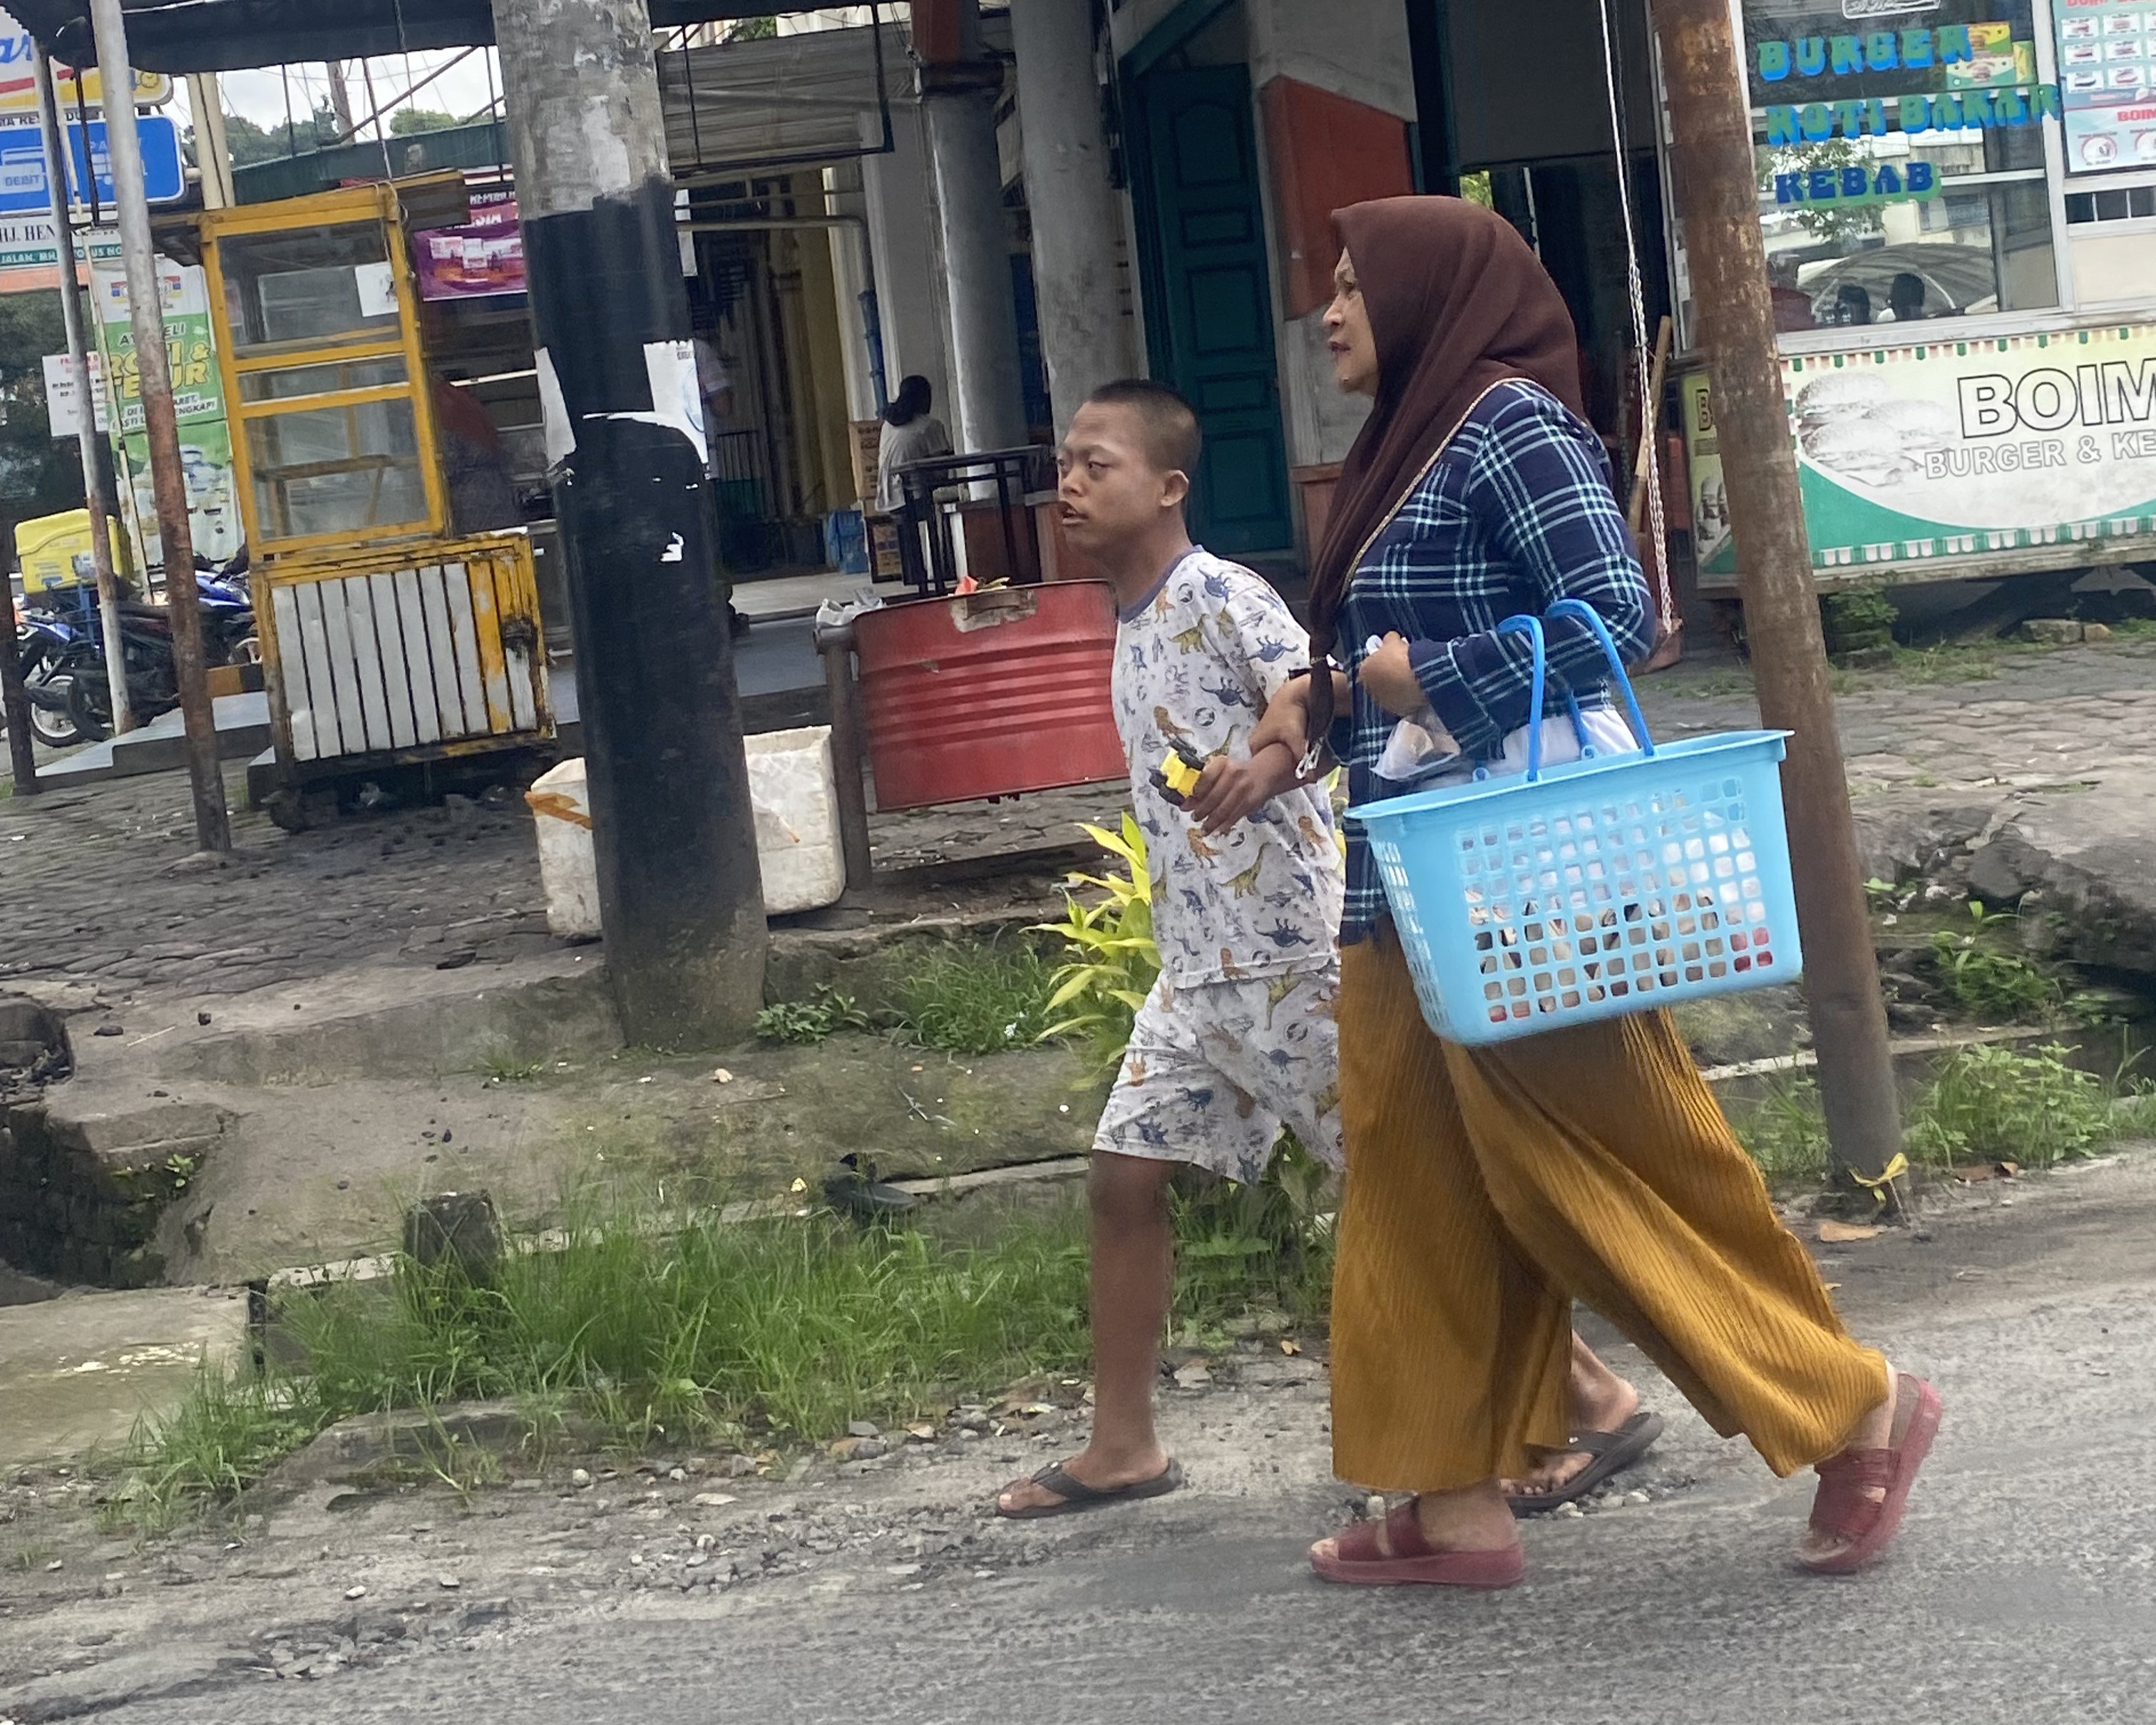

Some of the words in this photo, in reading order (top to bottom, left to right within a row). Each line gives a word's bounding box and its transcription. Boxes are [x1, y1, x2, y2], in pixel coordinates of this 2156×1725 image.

[1757, 24, 1972, 82] BURGER
[1765, 98, 1886, 146] ROTI
[5, 173, 40, 187] DEBIT
[1775, 162, 1941, 207] KEBAB
[191, 343, 211, 362] &
[1957, 358, 2156, 439] BOIM
[1924, 439, 2068, 480] BURGER
[2076, 434, 2102, 464] &
